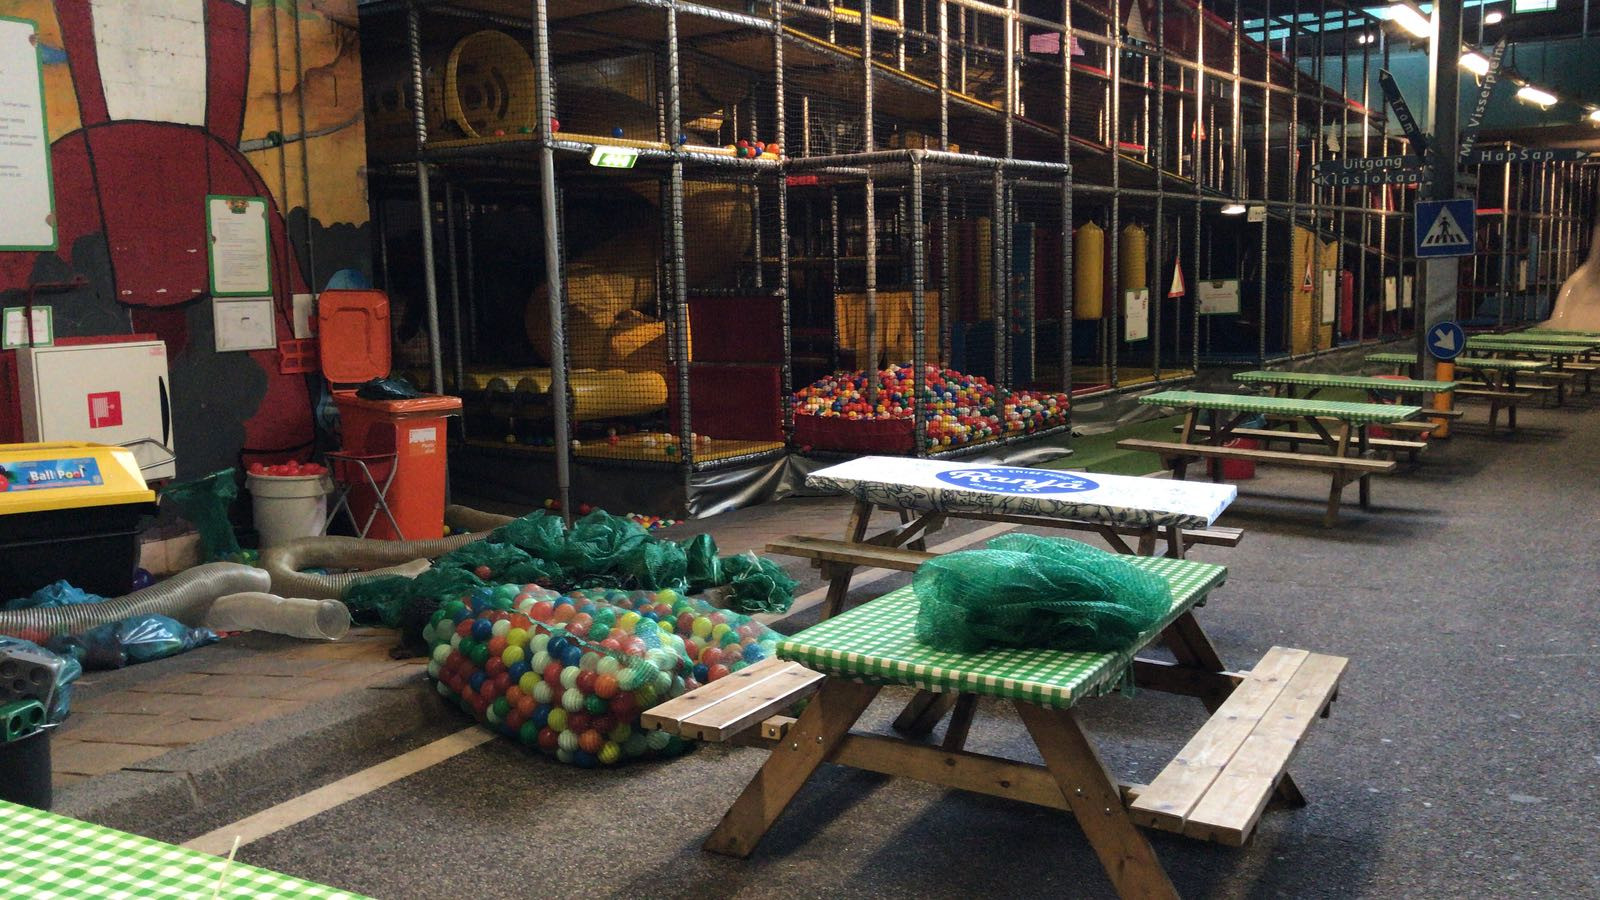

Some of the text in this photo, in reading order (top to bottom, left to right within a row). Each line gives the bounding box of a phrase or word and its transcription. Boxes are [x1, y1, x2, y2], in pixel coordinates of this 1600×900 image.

[1460, 48, 1504, 157] Mr. Visserplein
[1392, 97, 1414, 135] Tram
[1343, 157, 1403, 171] Uitgang
[1481, 149, 1554, 162] HapSap
[29, 465, 85, 481] Ball Pool
[948, 470, 1087, 491] Ranja
